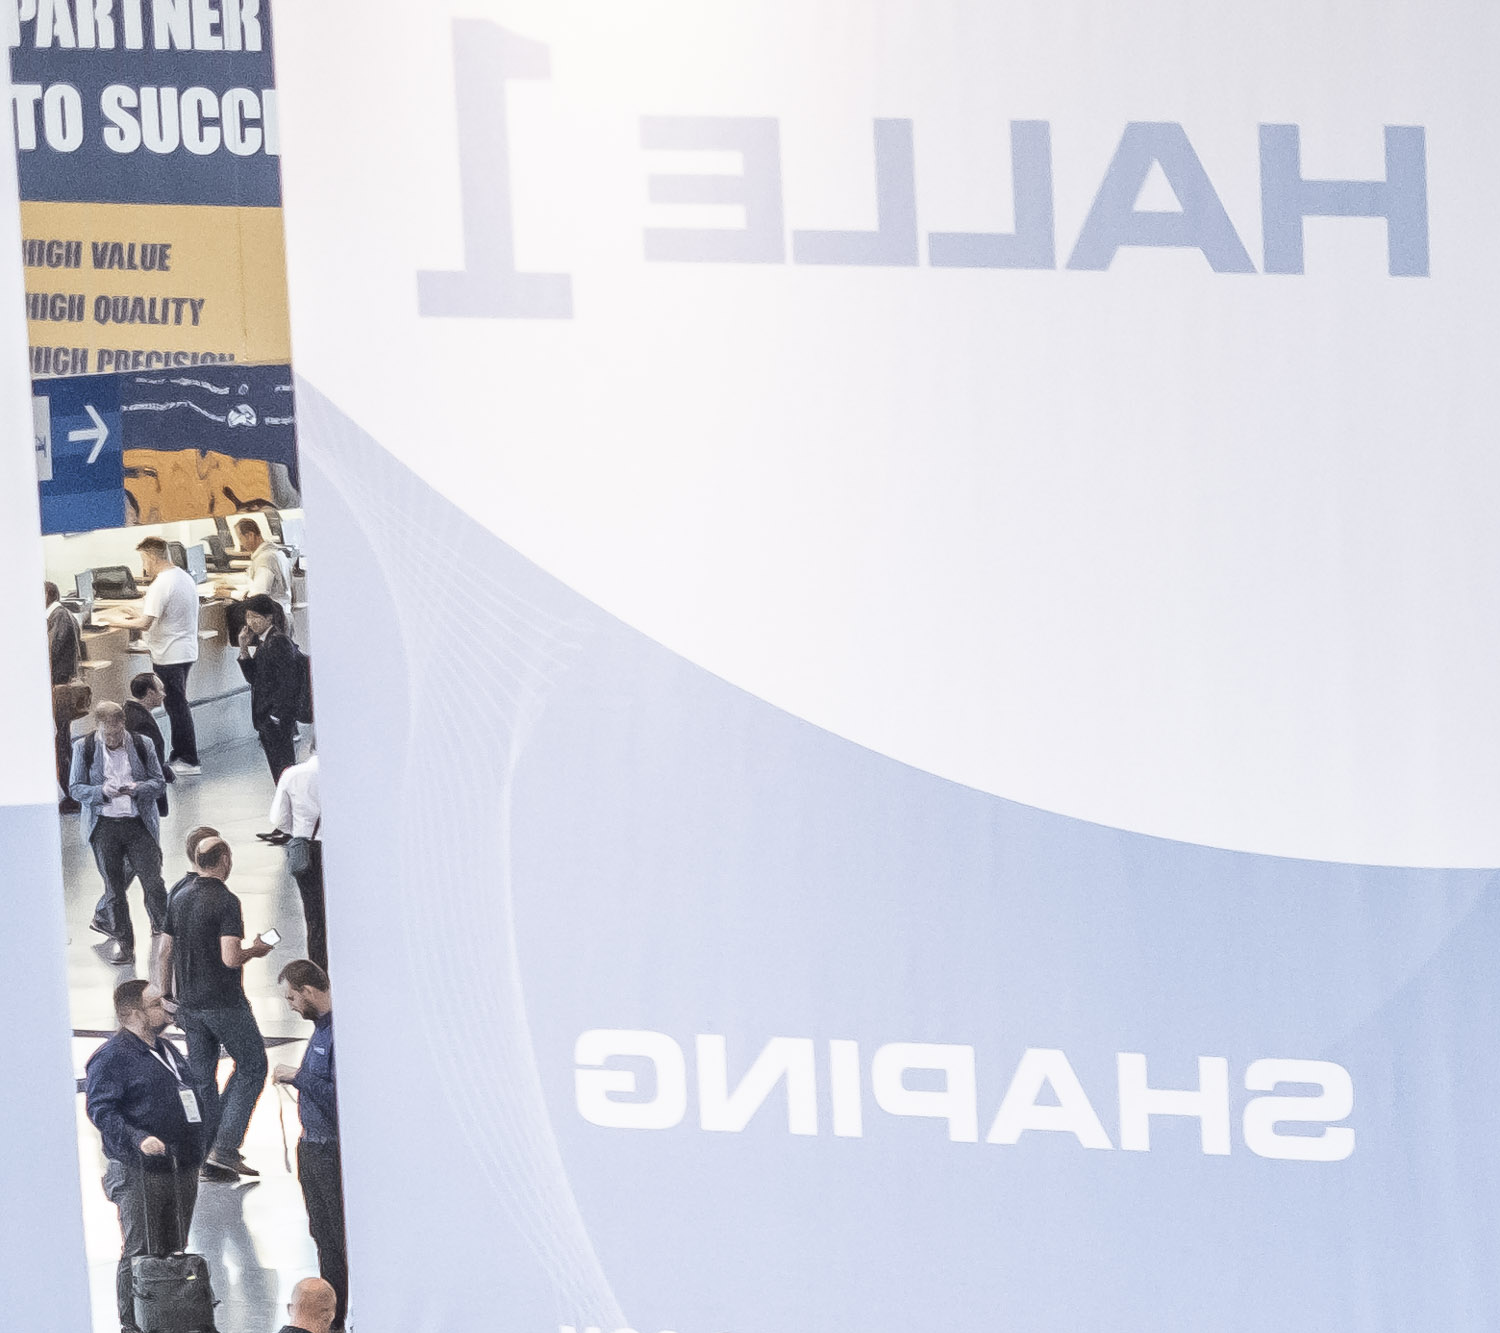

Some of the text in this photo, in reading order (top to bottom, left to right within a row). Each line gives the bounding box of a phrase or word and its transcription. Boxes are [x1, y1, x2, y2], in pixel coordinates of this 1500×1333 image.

[14, 0, 262, 51] PARTNER
[12, 83, 84, 153] TO
[91, 241, 172, 272] VALUE
[94, 295, 206, 327] QUALITY
